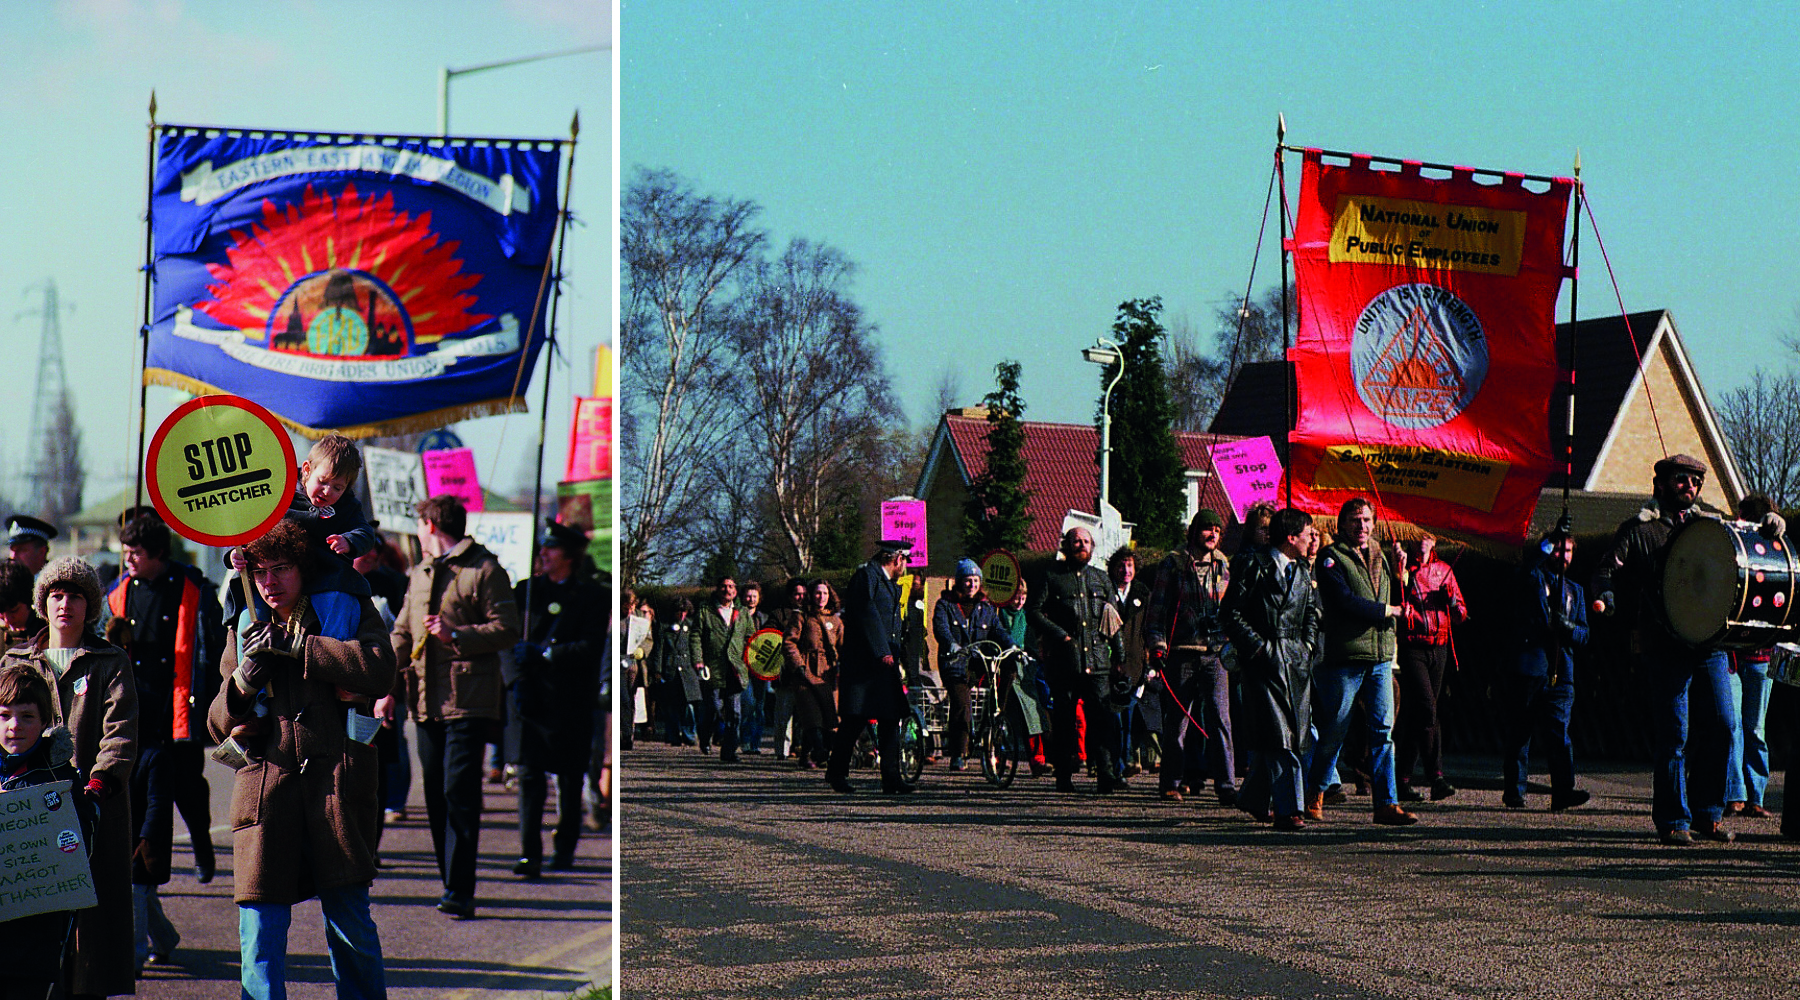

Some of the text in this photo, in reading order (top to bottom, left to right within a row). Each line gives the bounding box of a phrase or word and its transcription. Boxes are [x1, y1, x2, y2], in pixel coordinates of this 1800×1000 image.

[216, 156, 295, 190] EASTERN
[307, 152, 352, 166] EAST
[440, 165, 490, 198] EGION
[1357, 286, 1482, 341] UNITY IS STRENGTH
[259, 352, 297, 368] FIRE
[300, 362, 377, 379] BRIGADES
[385, 360, 438, 378] UNION
[183, 432, 253, 481] STOP
[1234, 463, 1268, 475] Stop
[1251, 479, 1275, 491] the
[183, 482, 272, 512] THATCHER
[894, 519, 917, 530] Stop
[990, 563, 1011, 580] STOP
[755, 638, 775, 664] STOP
[6, 799, 32, 814] ON
[19, 837, 48, 850] OWN
[4, 853, 42, 869] SIZE
[0, 873, 91, 906] THATCHER
